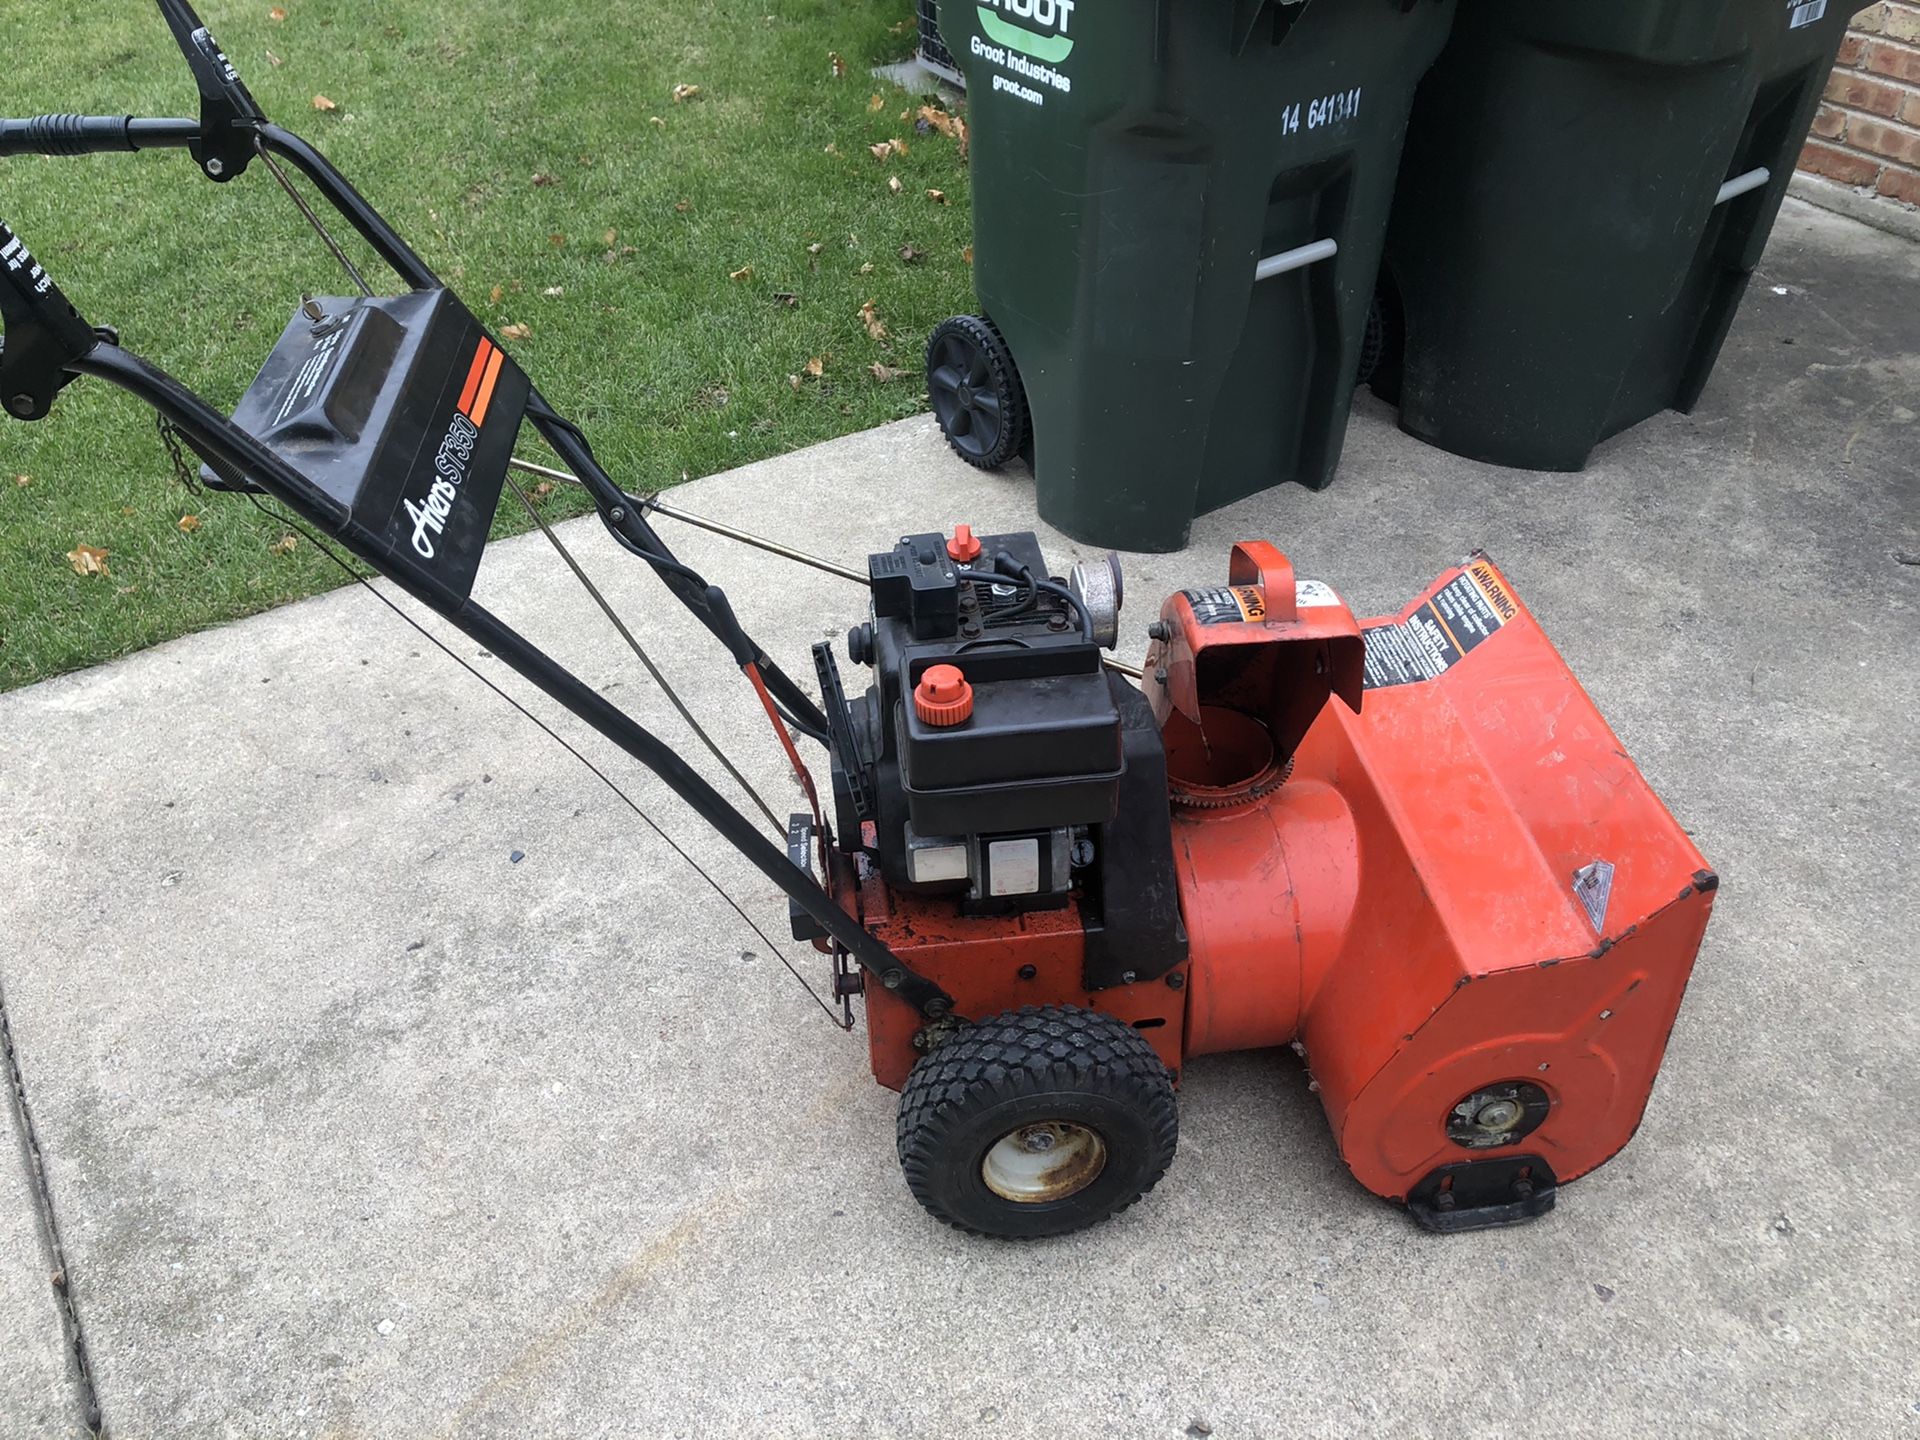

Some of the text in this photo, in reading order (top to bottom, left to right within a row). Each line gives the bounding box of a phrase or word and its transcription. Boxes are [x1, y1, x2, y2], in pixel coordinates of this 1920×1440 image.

[983, 0, 1075, 33] OOT
[971, 35, 1071, 92] Groot Industries
[992, 74, 1044, 105] groot.com
[1282, 87, 1361, 135] 14 641341
[403, 412, 478, 559] Ariens ST350
[1450, 581, 1465, 599] Keep
[1476, 570, 1518, 620] WARNING
[1408, 614, 1450, 674] INSTRUCTIONS
[1424, 618, 1451, 652] SAFETY
